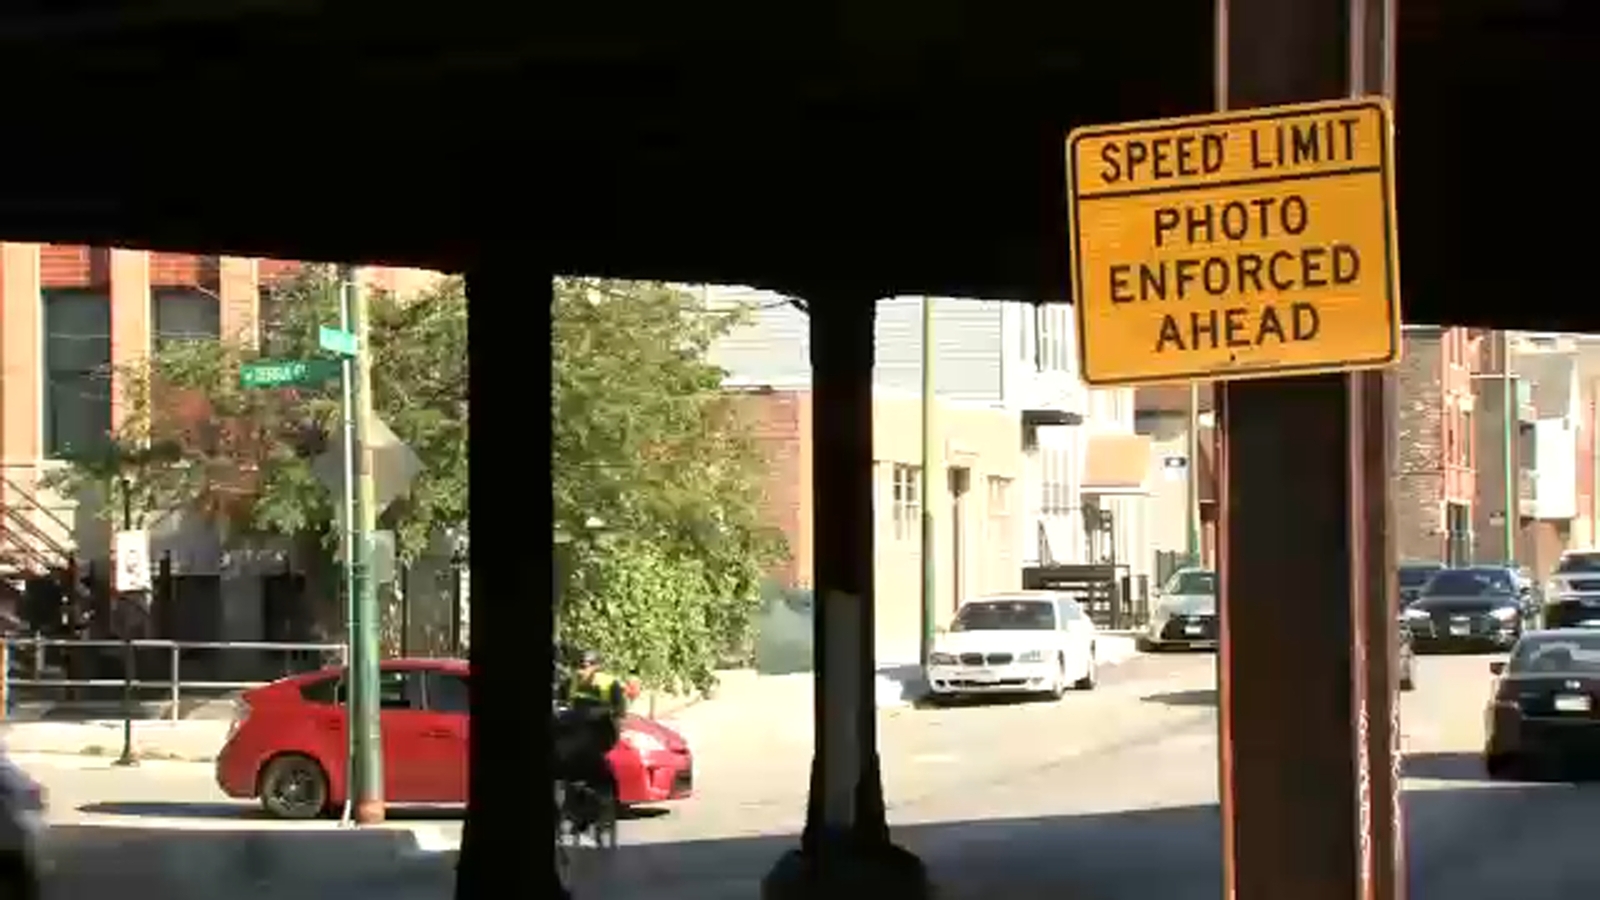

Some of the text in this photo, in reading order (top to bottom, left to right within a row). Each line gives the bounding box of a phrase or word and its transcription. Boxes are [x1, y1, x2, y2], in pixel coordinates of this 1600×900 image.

[1100, 118, 1360, 184] SPEED LIMIT
[1154, 195, 1308, 247] PHOTO
[1109, 244, 1361, 304] ENFORCED
[1155, 302, 1320, 353] AHEAD
